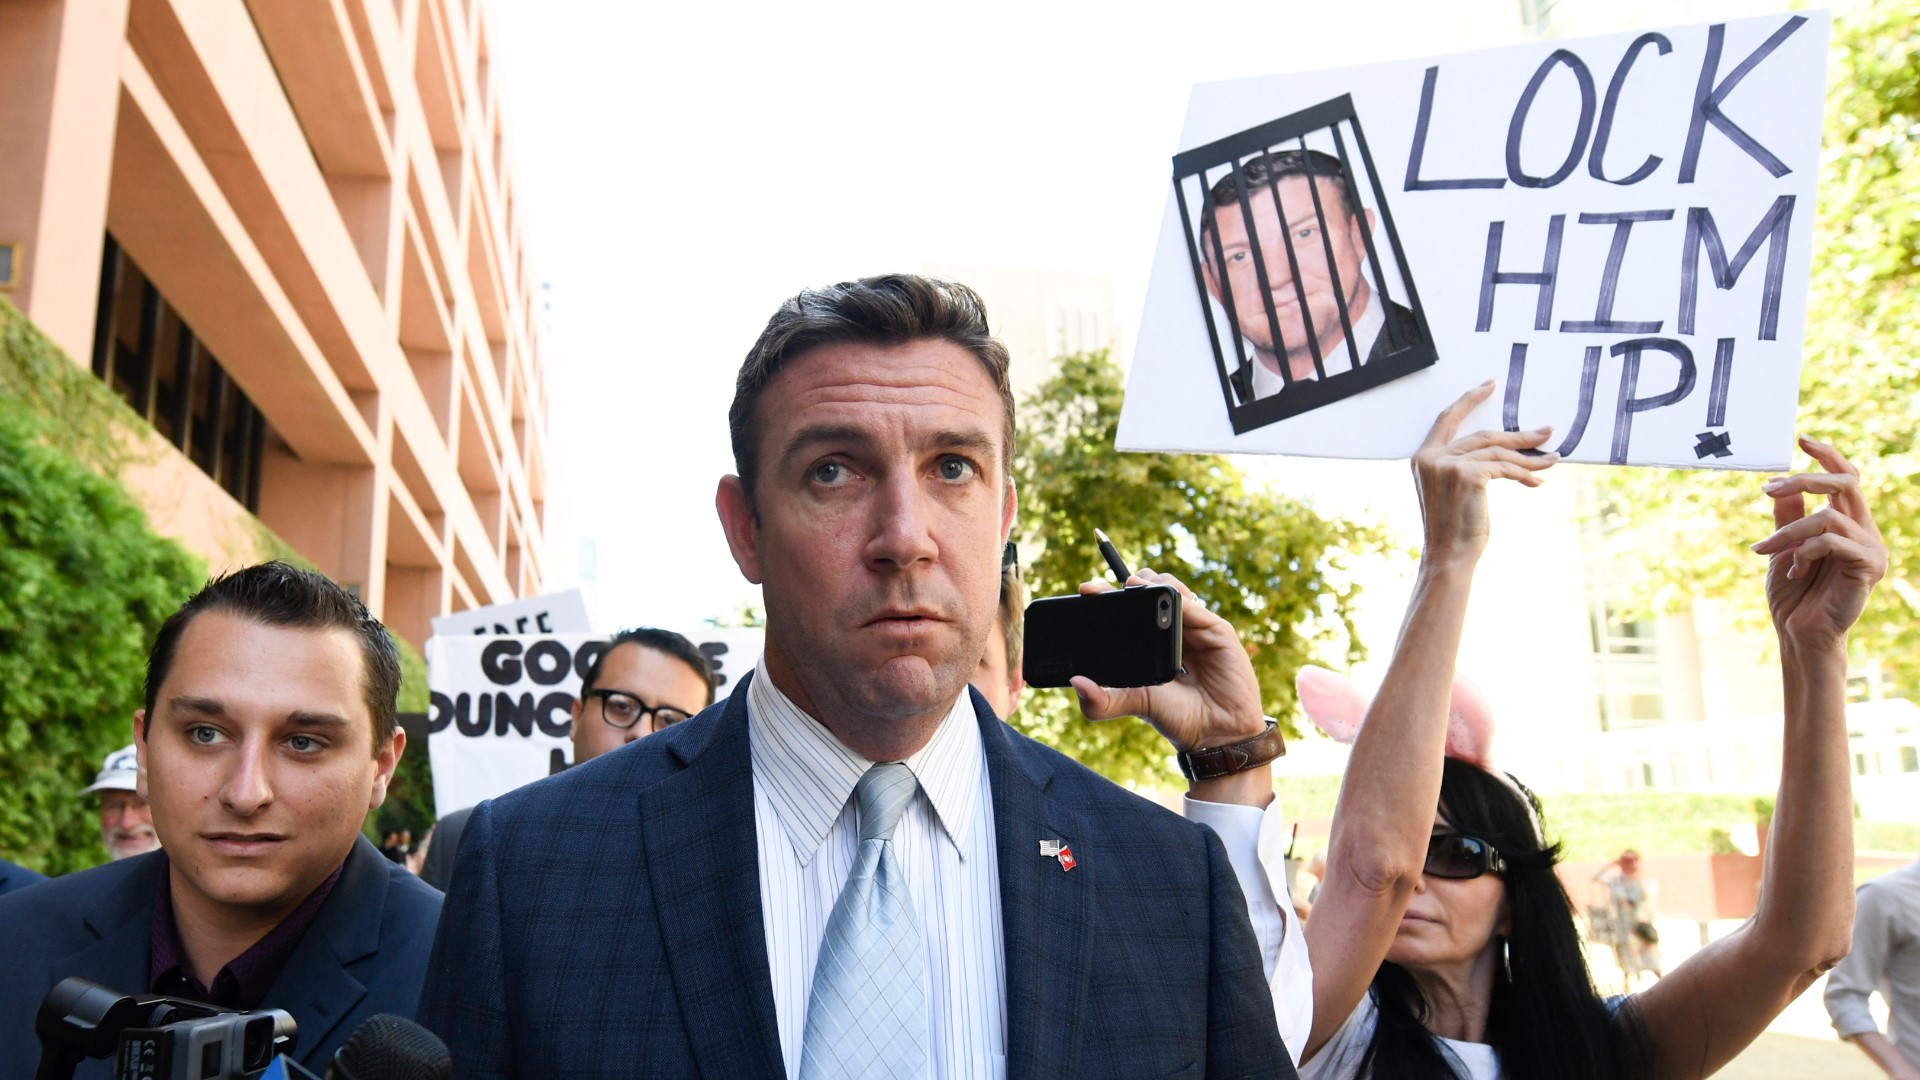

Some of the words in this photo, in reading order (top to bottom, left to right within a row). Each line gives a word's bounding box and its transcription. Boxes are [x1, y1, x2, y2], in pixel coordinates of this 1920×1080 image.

[1404, 15, 1809, 191] LOCK
[1475, 195, 1796, 340] HIM
[1502, 337, 1735, 465] UP!
